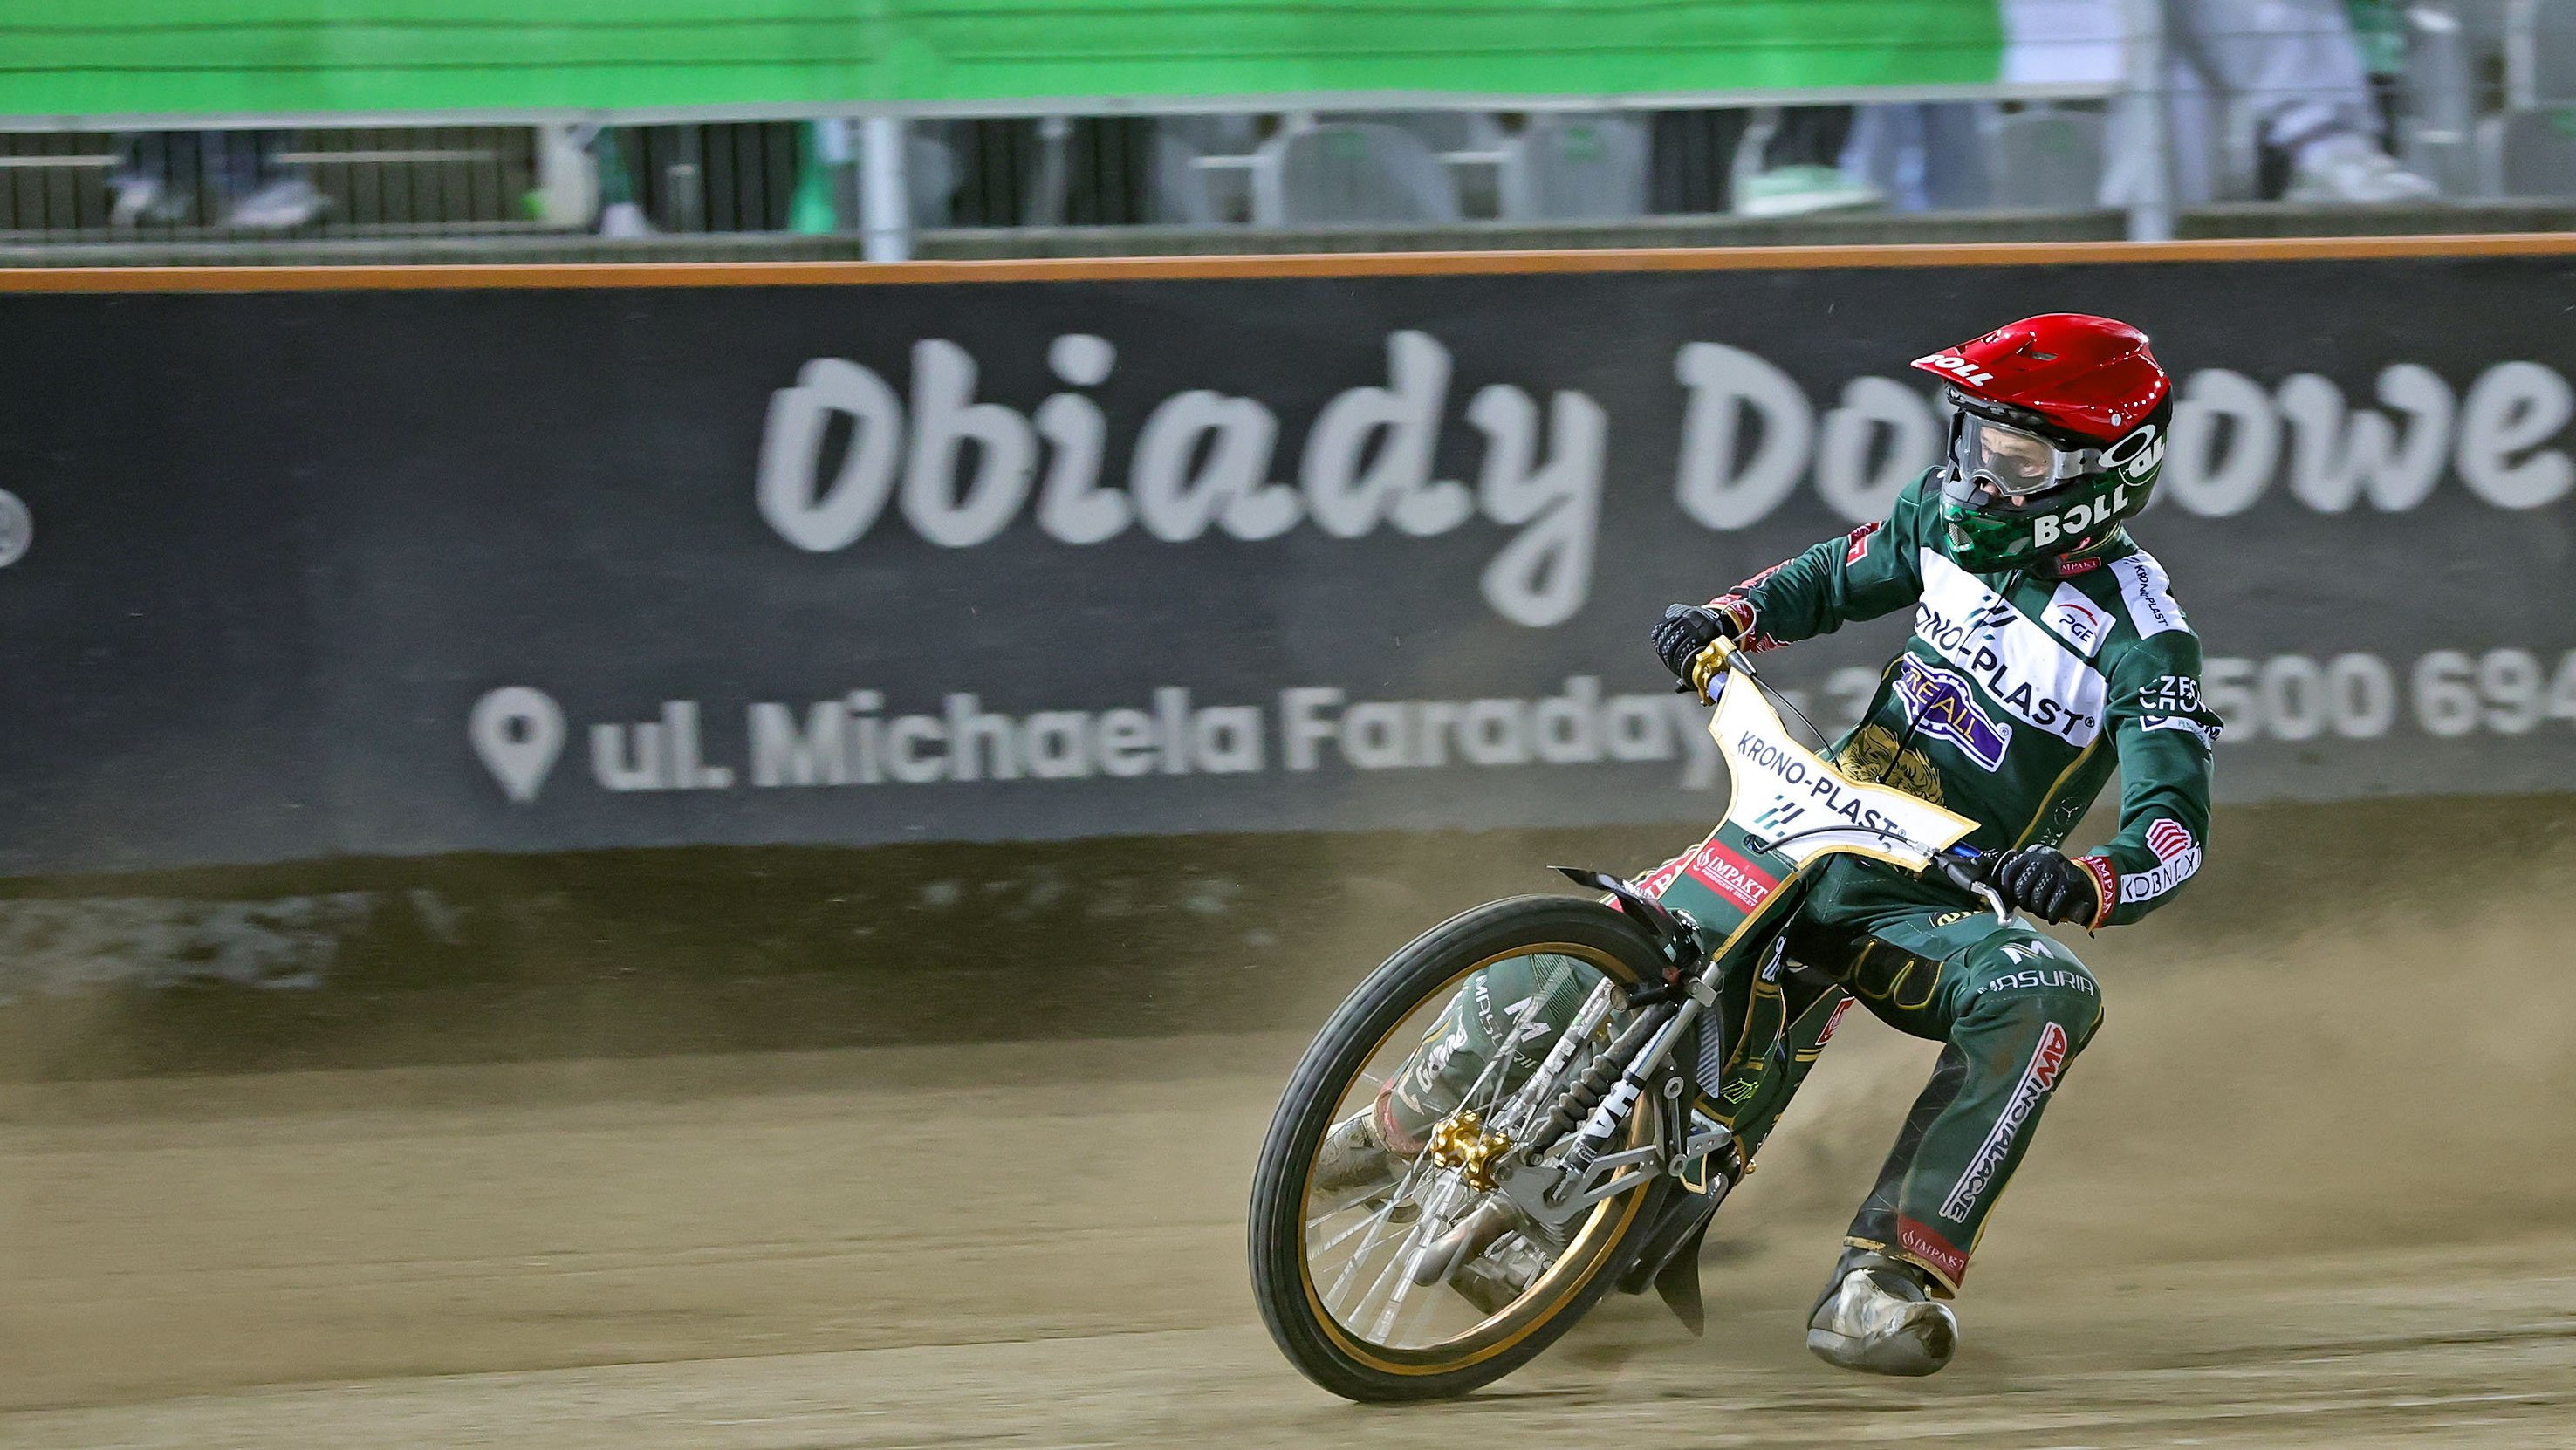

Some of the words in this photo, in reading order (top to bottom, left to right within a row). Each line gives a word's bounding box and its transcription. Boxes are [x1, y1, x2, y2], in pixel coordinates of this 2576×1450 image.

[756, 330, 1608, 626] Obiady
[1675, 342, 2576, 530] Doowe
[2059, 613, 2094, 643] PGE
[589, 700, 734, 791] ul.
[746, 687, 1266, 788] Michaela
[2202, 652, 2398, 742] 500
[1708, 855, 1769, 900] IMPAKT
